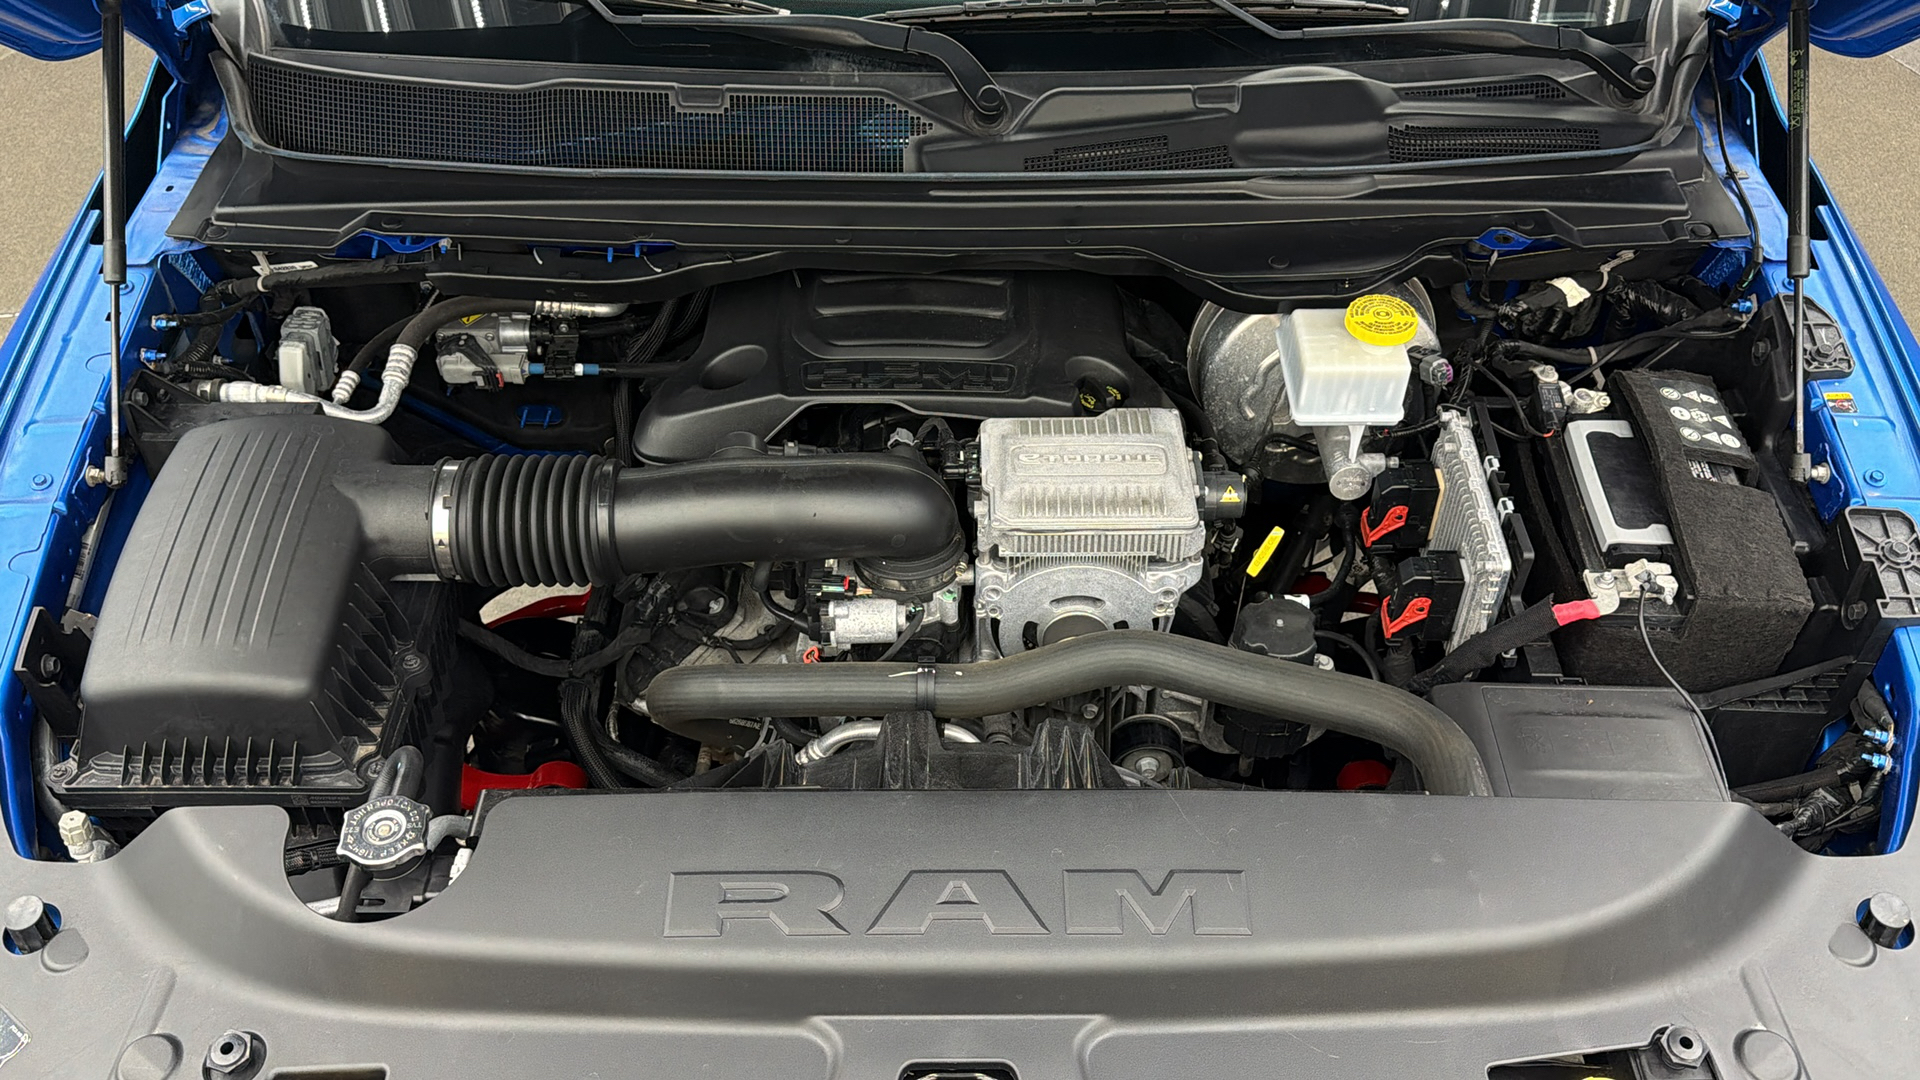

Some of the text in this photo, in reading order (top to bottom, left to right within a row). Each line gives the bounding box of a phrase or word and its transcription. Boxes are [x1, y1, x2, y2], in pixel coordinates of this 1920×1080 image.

[348, 838, 409, 859] KEEP TIGHT
[663, 868, 1253, 938] RAM
